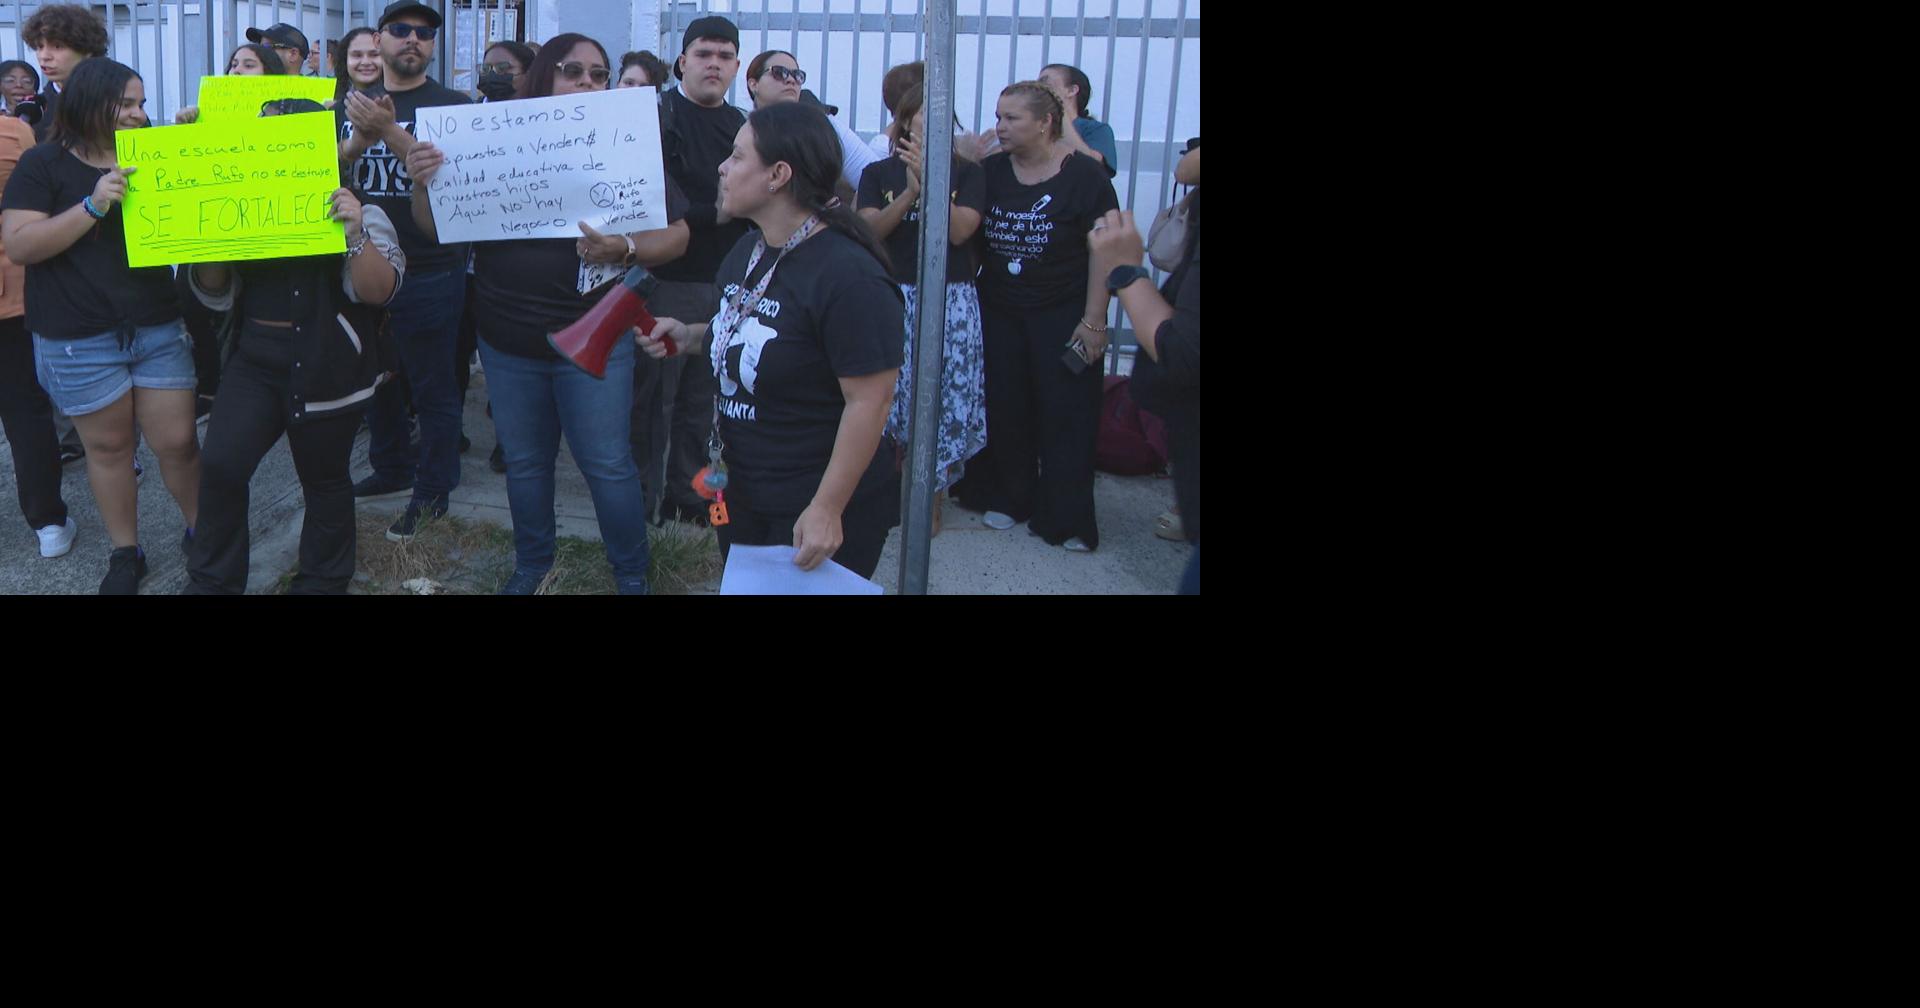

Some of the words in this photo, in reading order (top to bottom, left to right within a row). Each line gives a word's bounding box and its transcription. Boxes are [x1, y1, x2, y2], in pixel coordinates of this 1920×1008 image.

[471, 105, 586, 131] estamos
[179, 136, 256, 157] escuela
[266, 141, 316, 153] como
[516, 145, 524, 155] a
[155, 168, 198, 190] Padre
[212, 163, 245, 182] Rufo
[251, 170, 269, 180] no
[274, 168, 287, 177] se
[497, 161, 574, 182] educativa
[582, 153, 607, 171] de
[436, 188, 501, 207] nuestros
[505, 180, 549, 204] hijos
[534, 196, 563, 212] hay
[138, 203, 174, 240] SE
[199, 190, 333, 236] FORTALECE
[1012, 220, 1025, 231] de
[718, 397, 757, 421] VANTA
